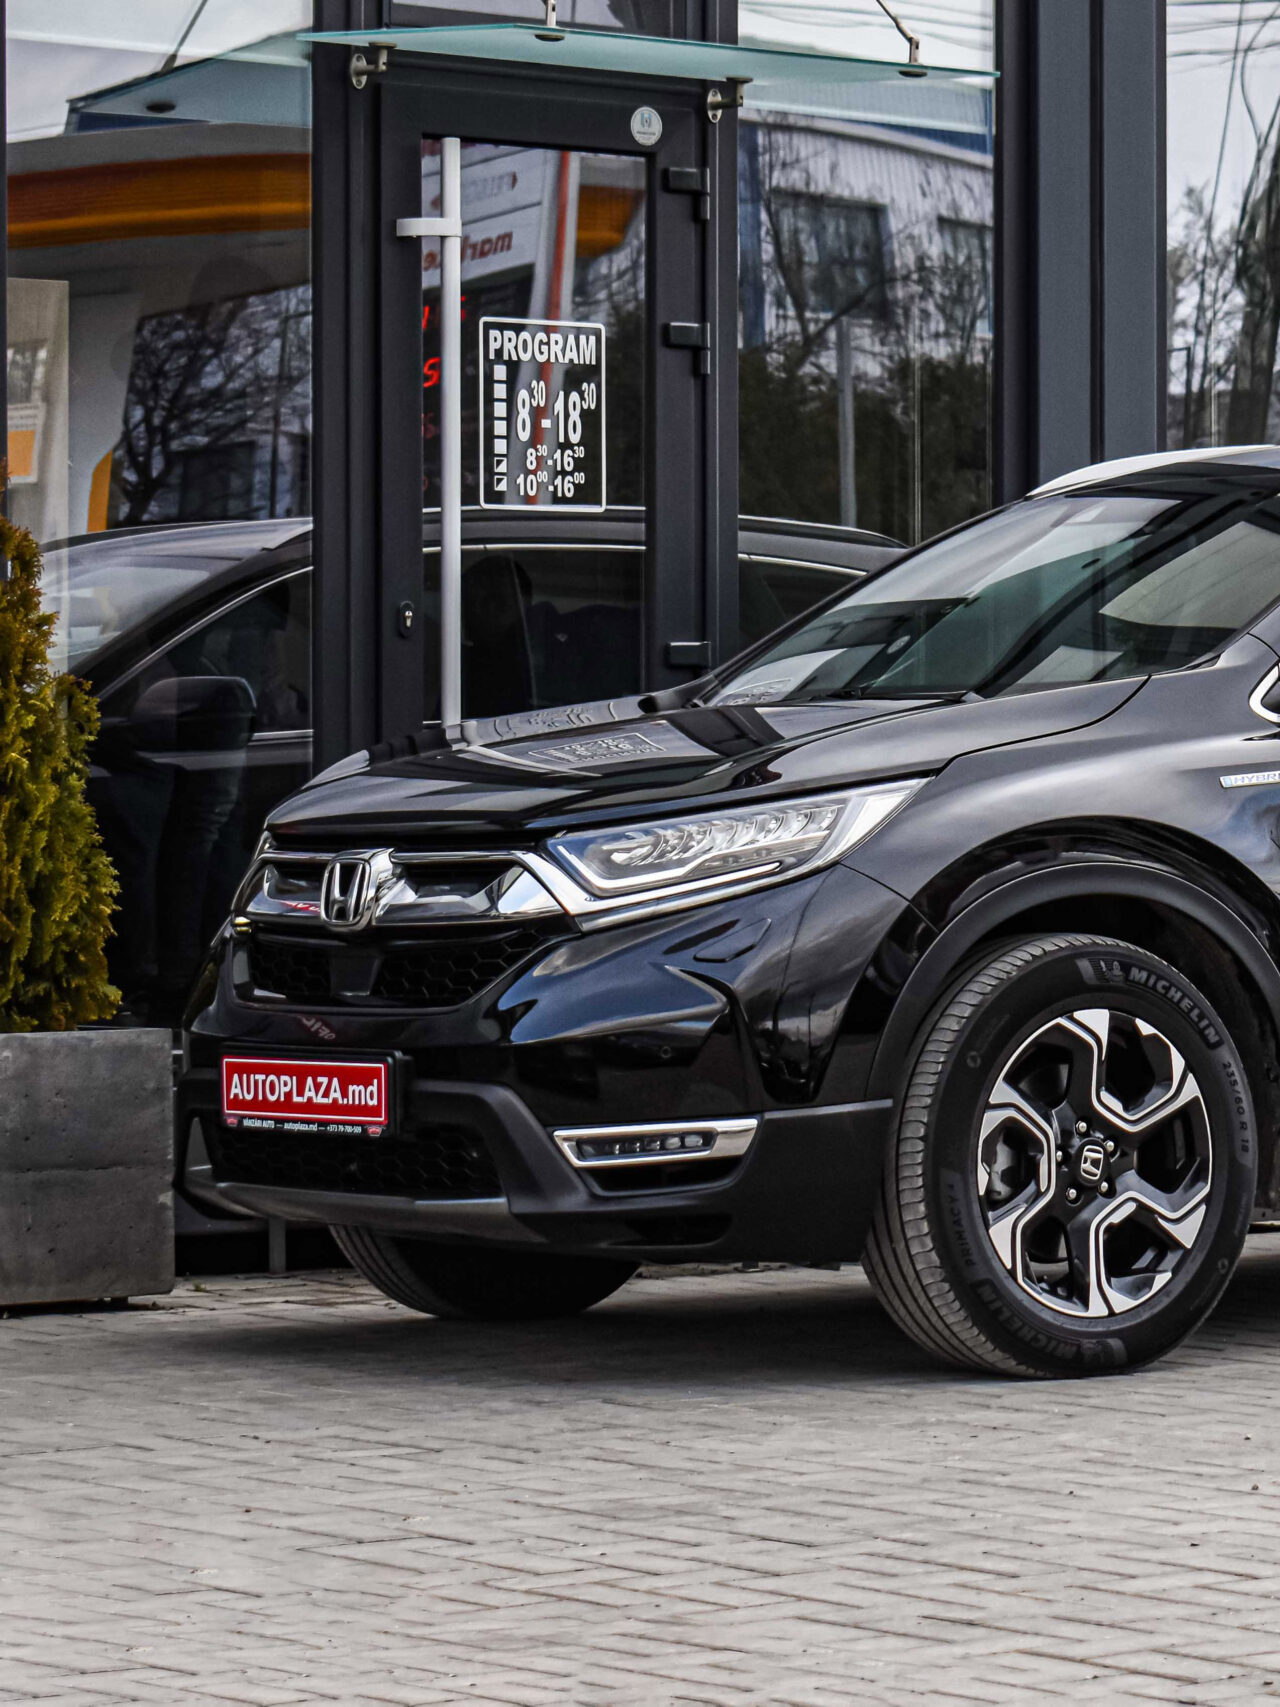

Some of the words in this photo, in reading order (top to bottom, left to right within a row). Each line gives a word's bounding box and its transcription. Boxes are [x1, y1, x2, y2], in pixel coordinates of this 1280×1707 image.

[489, 329, 596, 365] PROGRAM
[1129, 966, 1221, 1044] MICHELIN
[230, 1073, 378, 1106] AUTOPLAZA.md
[1222, 1061, 1244, 1115] 235/60
[284, 1121, 317, 1132] autoplaza.md
[1239, 1122, 1248, 1131] R
[1241, 1138, 1249, 1153] 18
[948, 1193, 976, 1267] PRIMACY
